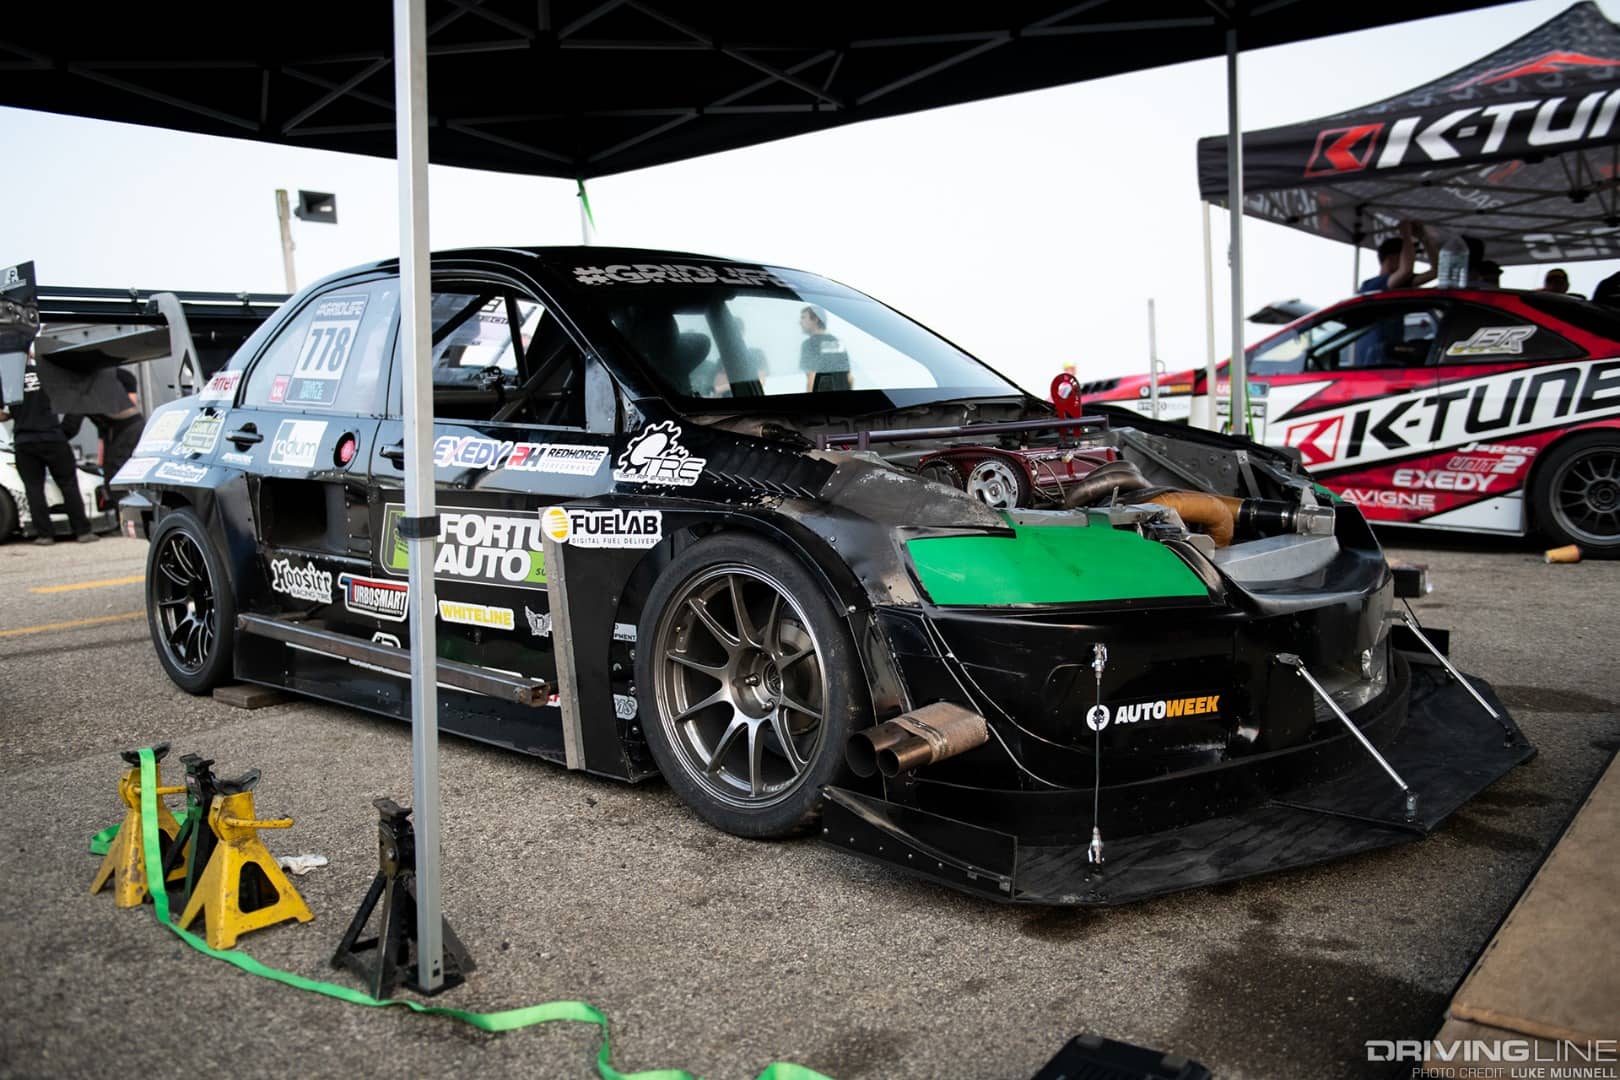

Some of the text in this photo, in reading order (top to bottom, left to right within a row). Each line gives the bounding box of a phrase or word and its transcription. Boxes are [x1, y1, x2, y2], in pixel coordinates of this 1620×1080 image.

[301, 327, 350, 371] 778
[1345, 359, 1620, 458] K-TUNE
[433, 438, 508, 466] EXEDY
[508, 446, 605, 467] RH REDHORSE
[1392, 469, 1499, 492] EXEDY
[570, 514, 659, 535] FUELAB
[571, 536, 601, 545] DIGITAL
[434, 543, 532, 581] AUTO
[271, 559, 331, 595] Hoosier
[341, 576, 407, 612] TURBOSMART
[440, 603, 513, 626] WHITELINE
[1114, 696, 1220, 725] AUTOWEEK
